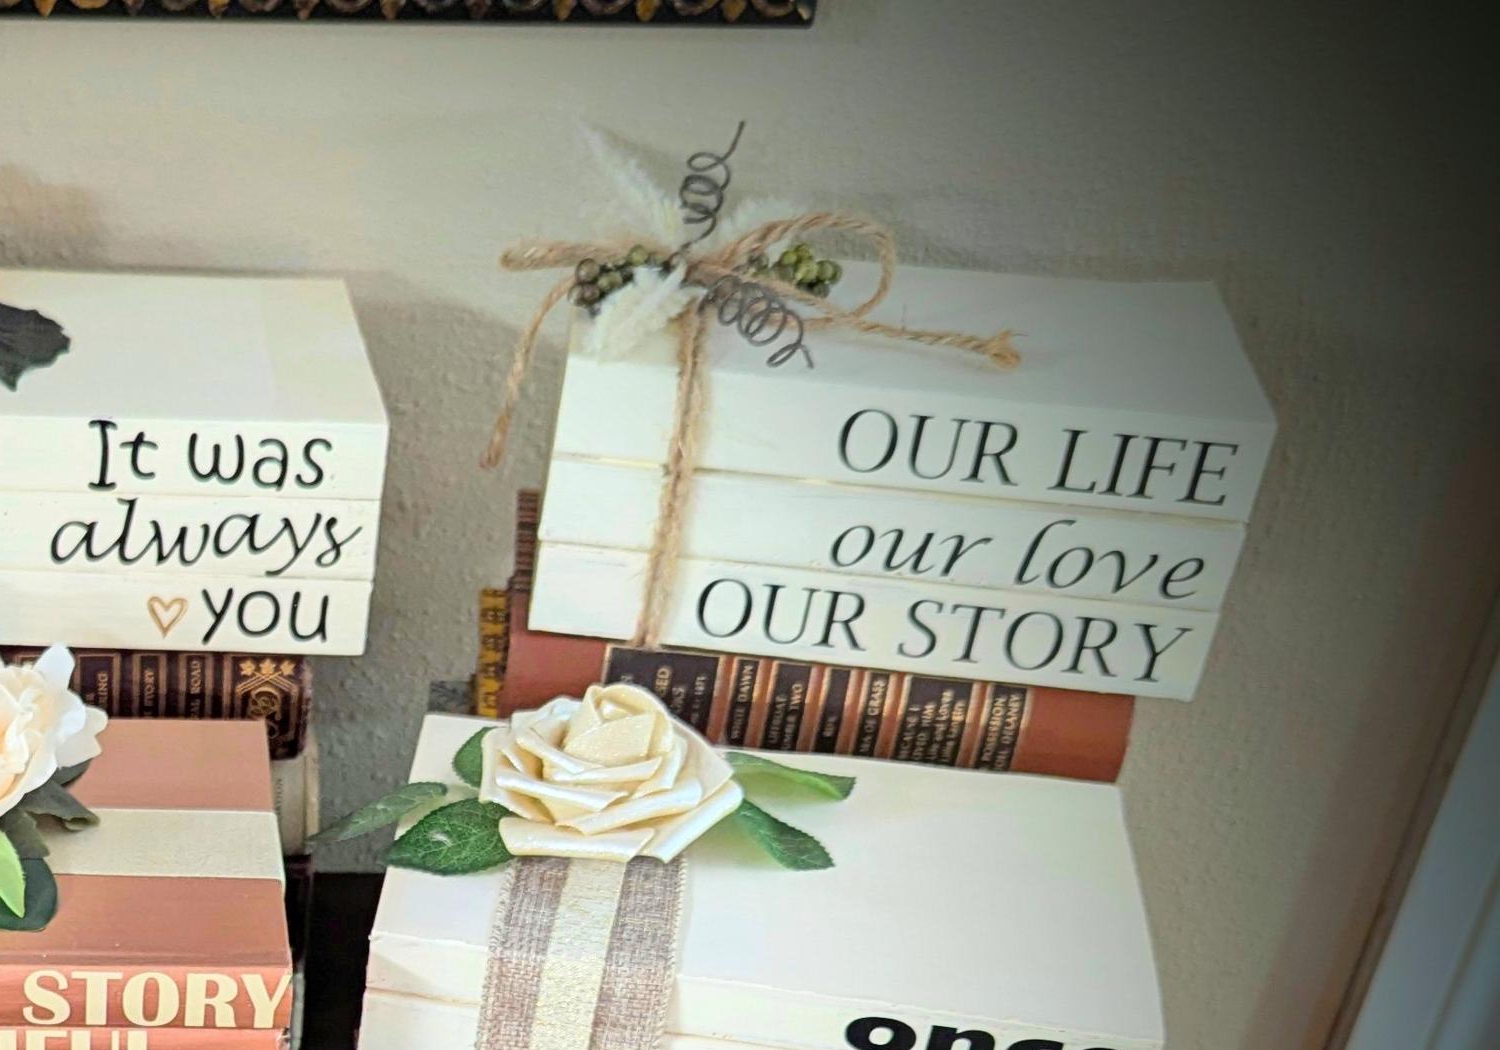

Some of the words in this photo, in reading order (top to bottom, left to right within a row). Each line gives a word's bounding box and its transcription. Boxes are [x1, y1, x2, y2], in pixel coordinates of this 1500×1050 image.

[88, 419, 159, 491] It
[188, 432, 333, 492] was
[837, 408, 1019, 487] OUR
[1046, 428, 1239, 507] LIFE
[51, 497, 364, 577] always
[829, 523, 994, 578] our
[1013, 519, 1205, 600] love
[201, 587, 330, 646] you
[697, 578, 867, 652] OUR
[896, 599, 1194, 683] STORY
[23, 970, 293, 1030] STORY
